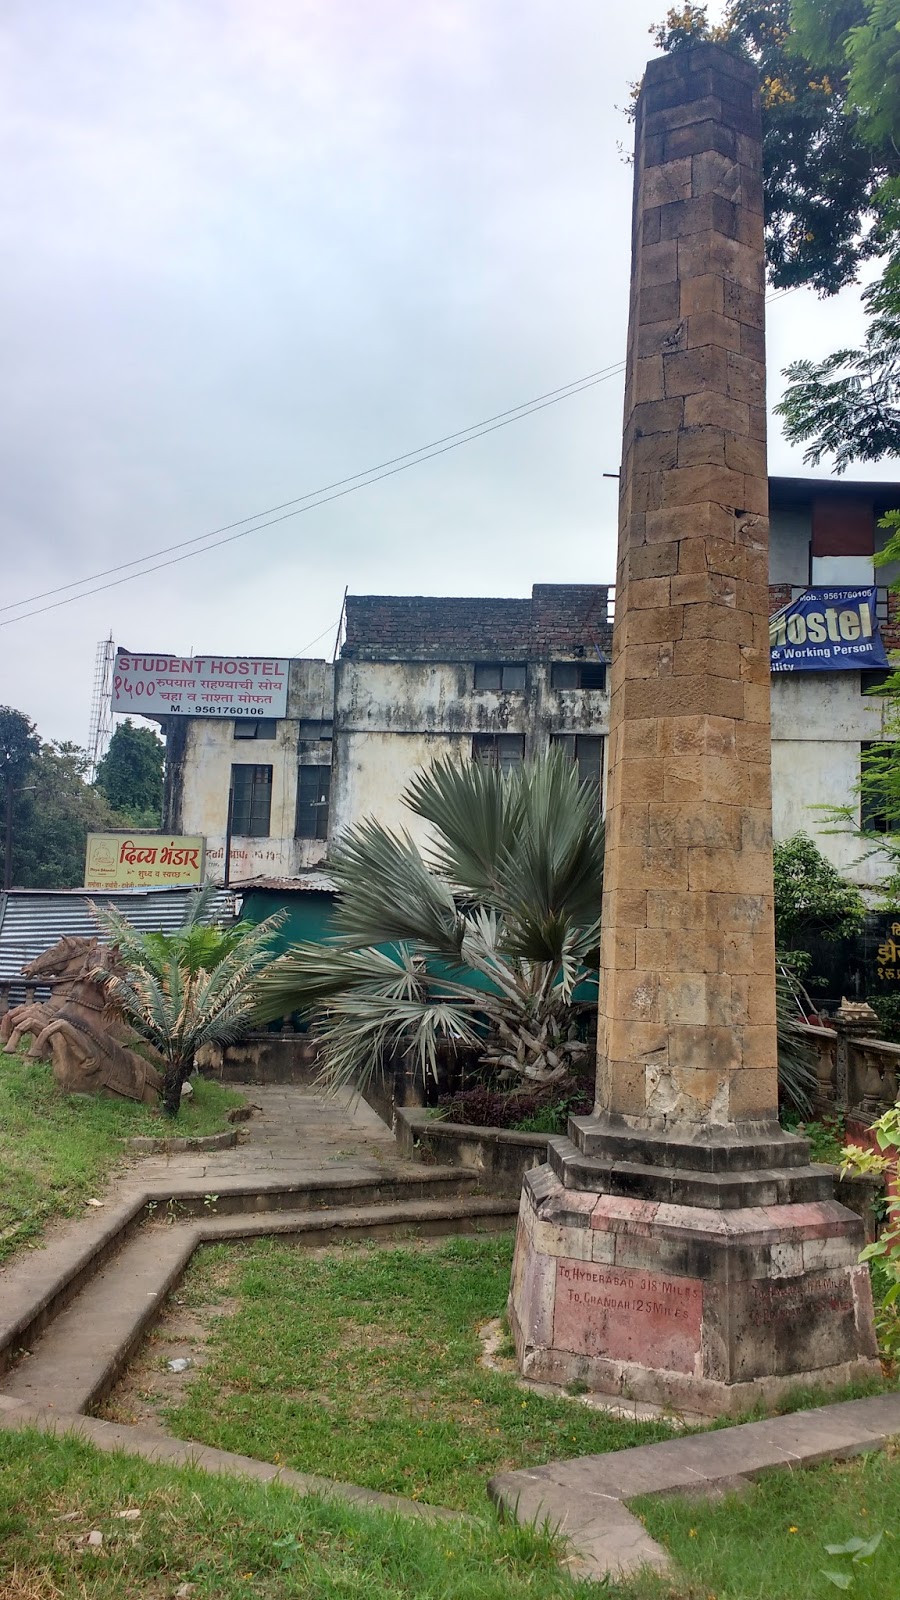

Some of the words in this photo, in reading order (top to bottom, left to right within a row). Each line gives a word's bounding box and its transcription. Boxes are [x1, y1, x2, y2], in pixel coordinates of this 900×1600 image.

[823, 589, 872, 600] 9561760106
[771, 650, 781, 659] &
[783, 647, 831, 659] Working
[833, 643, 873, 655] Person
[118, 657, 205, 674] STUDENT
[210, 660, 285, 676] HOSTEL
[114, 675, 156, 700] १५००
[200, 679, 253, 690] राहण्याची
[258, 679, 283, 690] सोय
[159, 691, 182, 702] चहा
[186, 692, 197, 701] व
[200, 693, 234, 703] नाश्ता
[237, 691, 272, 703] मोफत
[170, 705, 184, 713] M.
[195, 706, 264, 715] 9561760106
[119, 840, 158, 865] दिव्य
[159, 841, 199, 869] भंडार
[572, 1267, 634, 1289] HYDERABAD
[662, 1281, 698, 1299] MILES
[653, 1302, 689, 1319] MILES
